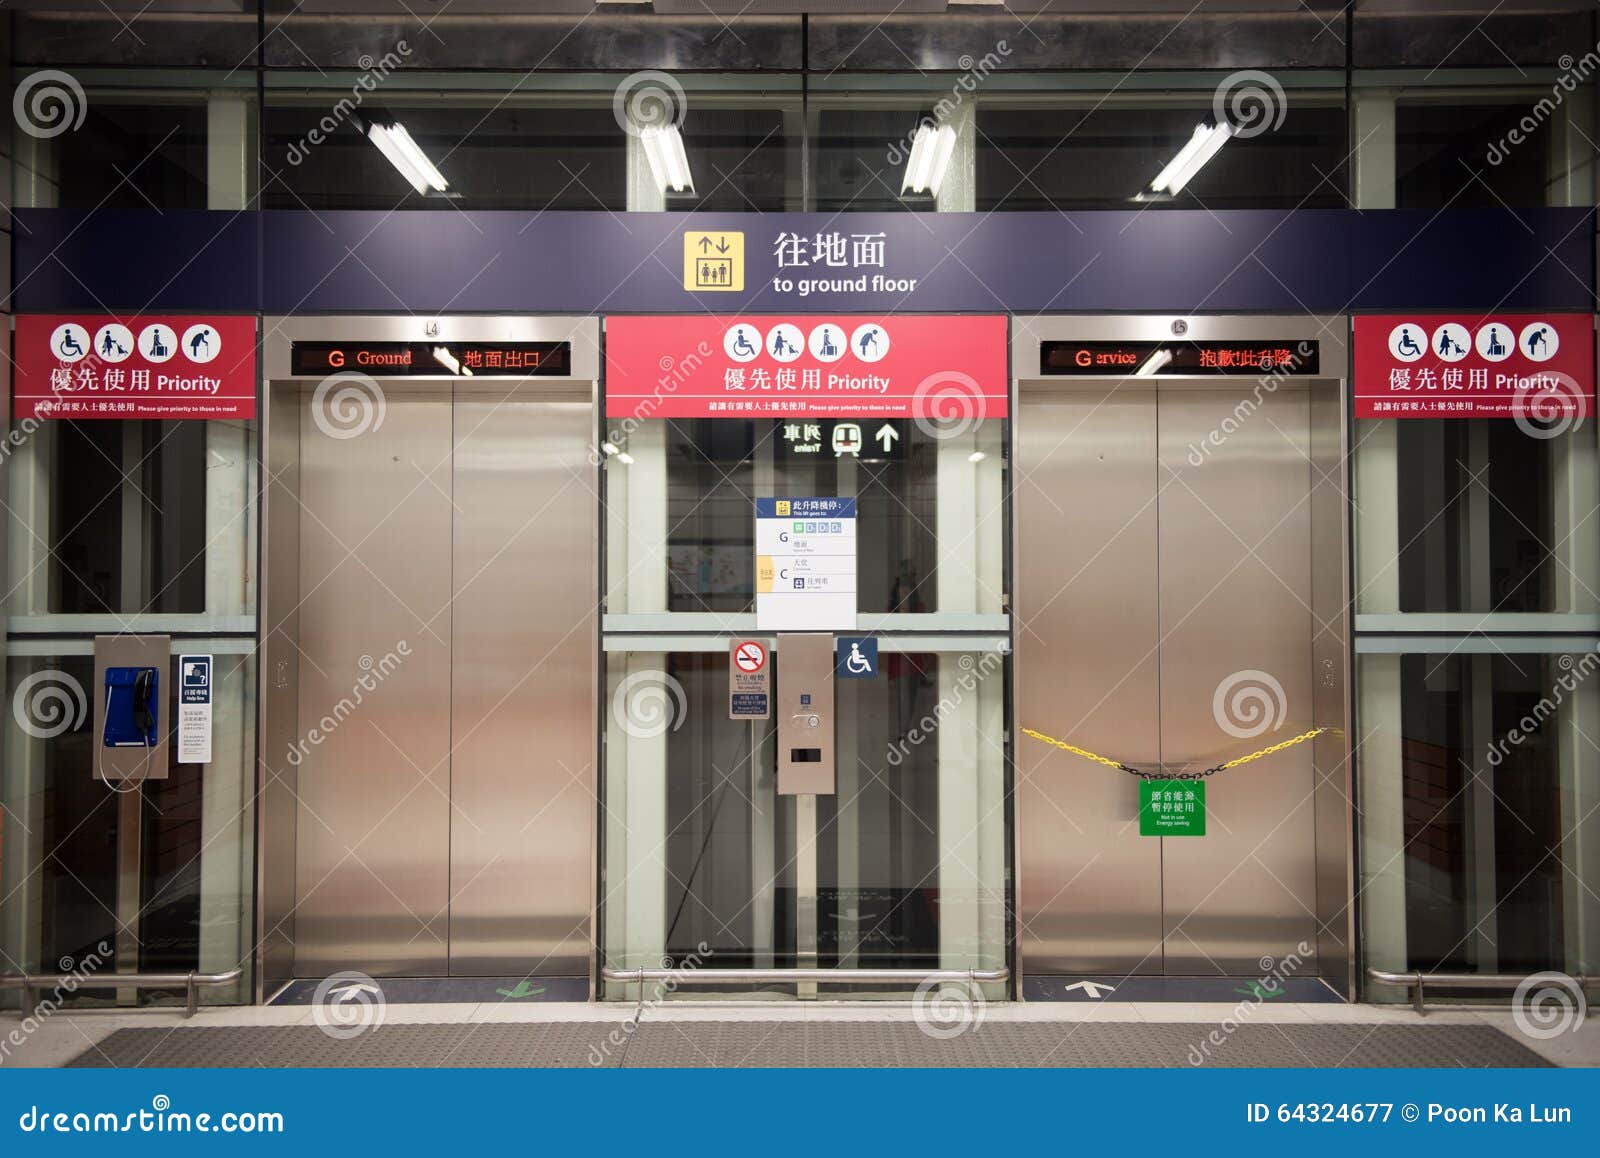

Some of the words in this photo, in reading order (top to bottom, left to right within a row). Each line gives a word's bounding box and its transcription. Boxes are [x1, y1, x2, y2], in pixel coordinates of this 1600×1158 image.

[774, 232, 886, 268] 往地面
[773, 277, 793, 292] to
[798, 275, 867, 296] ground
[871, 275, 917, 292] floor
[328, 350, 345, 367] G
[357, 350, 412, 366] Ground
[464, 351, 540, 368] 地面出口
[1075, 350, 1092, 367] G
[50, 367, 150, 391] 優先使用
[157, 375, 221, 394] Priority
[723, 367, 821, 391] 優先使用
[828, 374, 890, 393] Priority
[1389, 368, 1488, 391] 優先使用
[1496, 373, 1560, 393] Priority
[779, 532, 788, 542] G
[780, 569, 788, 579] C
